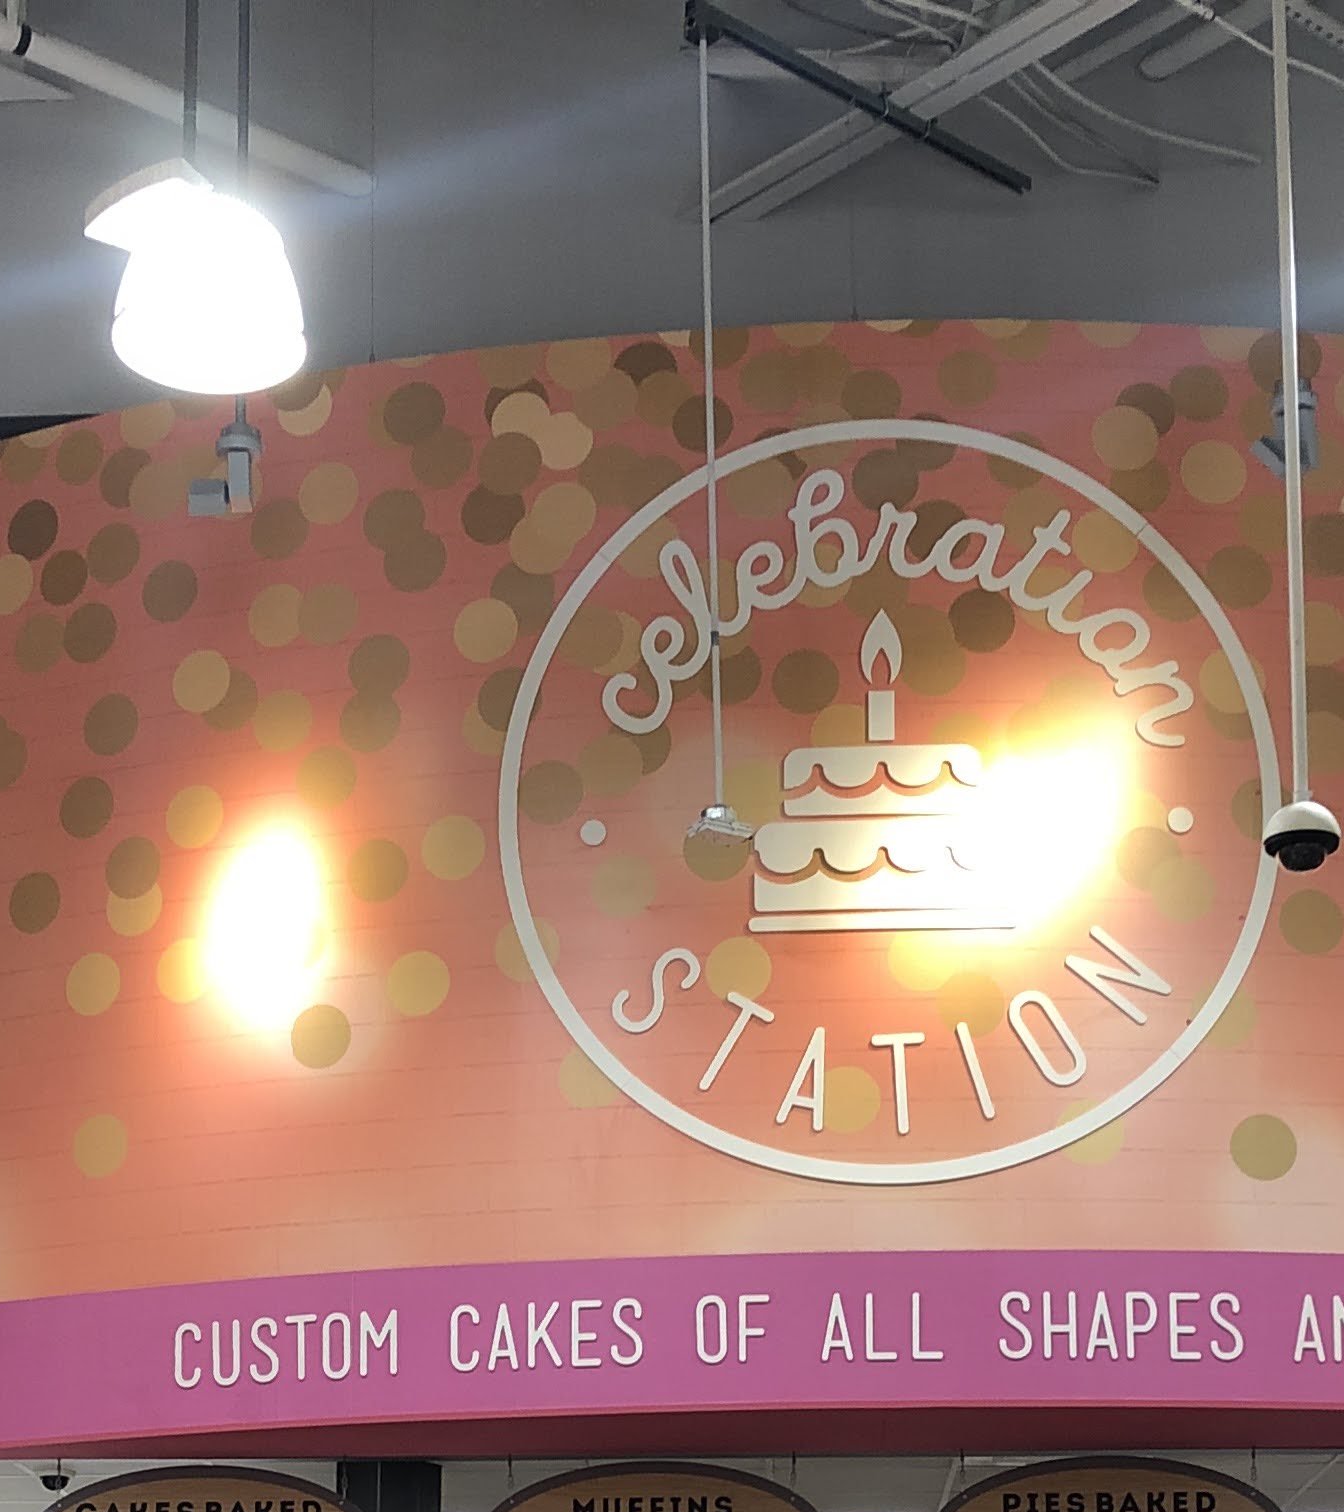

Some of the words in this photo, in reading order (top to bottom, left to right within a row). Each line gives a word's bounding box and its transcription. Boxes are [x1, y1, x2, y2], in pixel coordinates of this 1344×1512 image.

[612, 925, 1172, 1135] STATION
[173, 1309, 399, 1389] CUSTOM
[450, 1296, 644, 1373] CAKES
[695, 1294, 770, 1364] OF
[821, 1292, 944, 1362] ALL
[998, 1290, 1245, 1361] SHAPES
